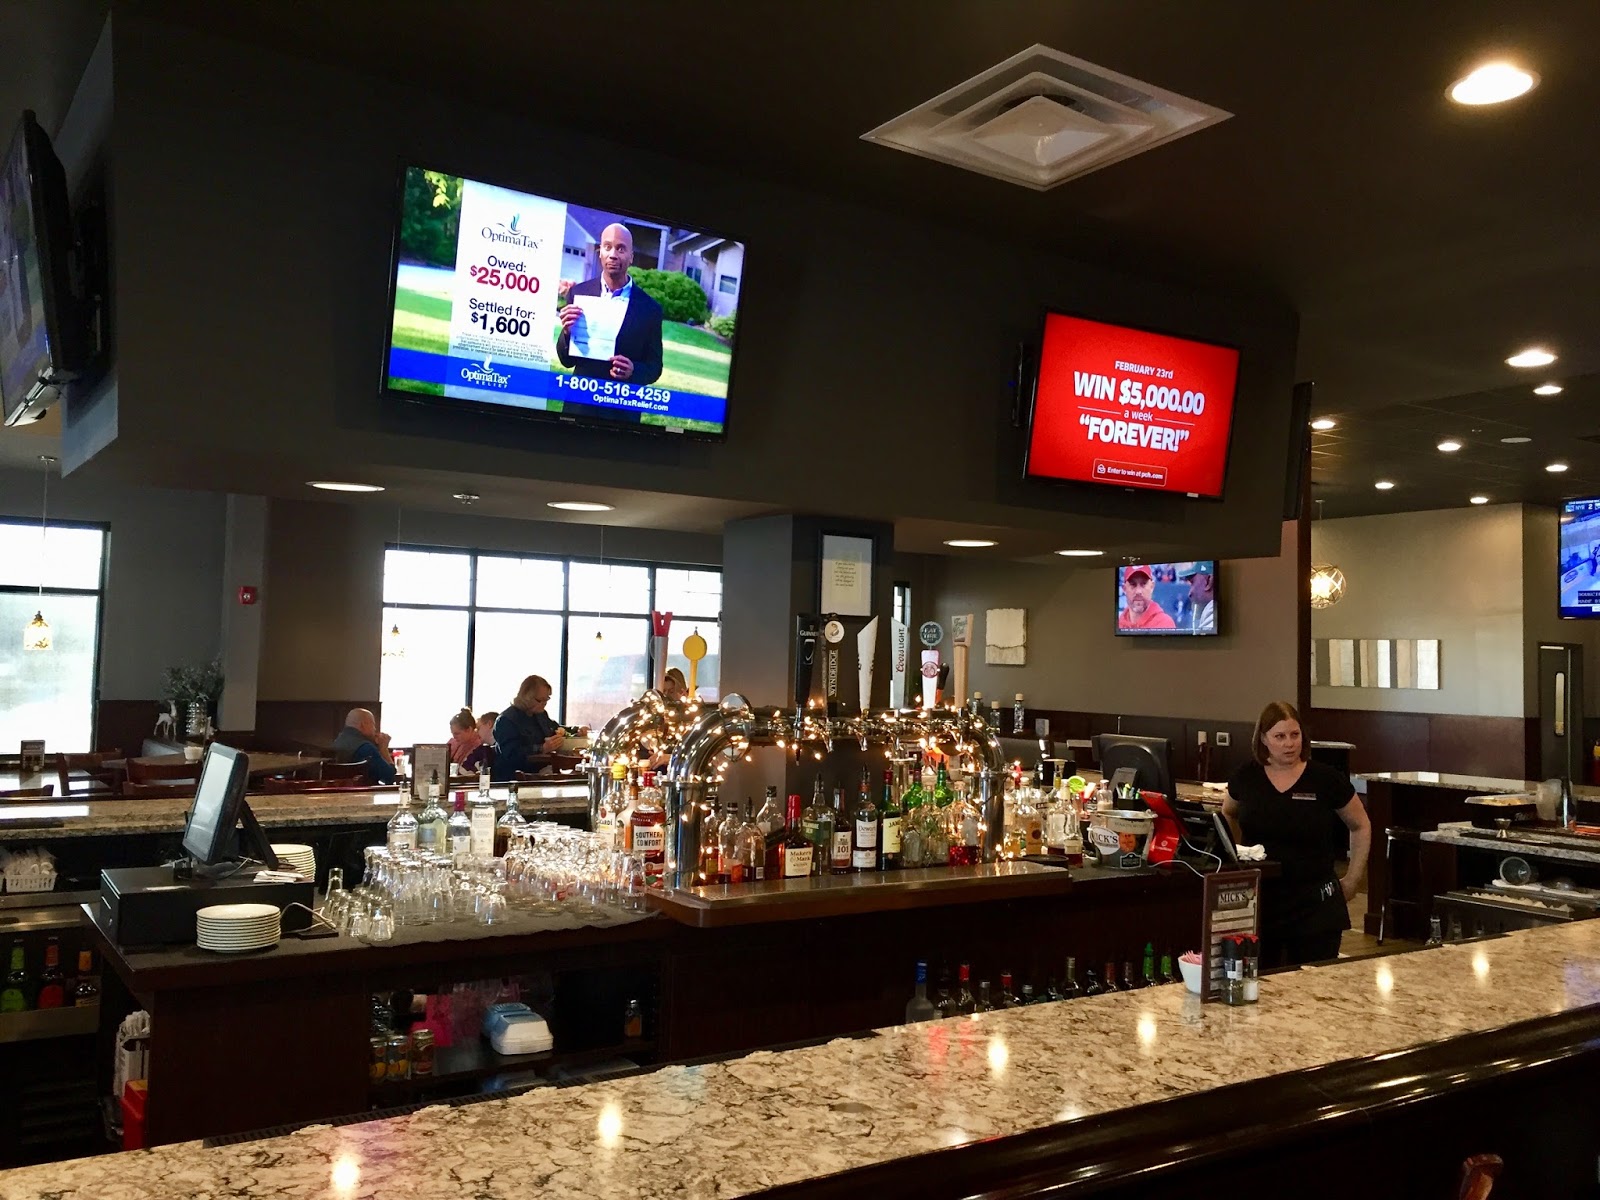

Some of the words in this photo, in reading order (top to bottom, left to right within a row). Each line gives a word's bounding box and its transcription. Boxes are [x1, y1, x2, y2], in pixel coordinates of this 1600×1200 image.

[487, 255, 527, 273] Owed:
[470, 265, 540, 294] $25,000
[469, 297, 513, 317] Settled
[515, 306, 536, 320] for:
[470, 311, 531, 338] $1,600
[1114, 360, 1155, 376] FEBRUARY
[1155, 368, 1174, 379] 23rd
[555, 374, 671, 403] 1-800-516-4259
[1073, 371, 1117, 402] WIN
[1119, 378, 1205, 416] $5,000.00
[593, 394, 669, 411] OptimaTaxRelief.com
[1123, 411, 1130, 419] a
[1131, 410, 1153, 422] week
[1107, 466, 1121, 475] Enter
[1127, 469, 1135, 477] win
[895, 649, 905, 673] Coors
[827, 648, 839, 697] WYNDRIDGE
[635, 831, 663, 839] SOUTHERN
[636, 838, 662, 847] COMFORT
[1094, 832, 1119, 844] ICK'S
[837, 845, 849, 853] 101
[1220, 890, 1246, 904] MICK'S
